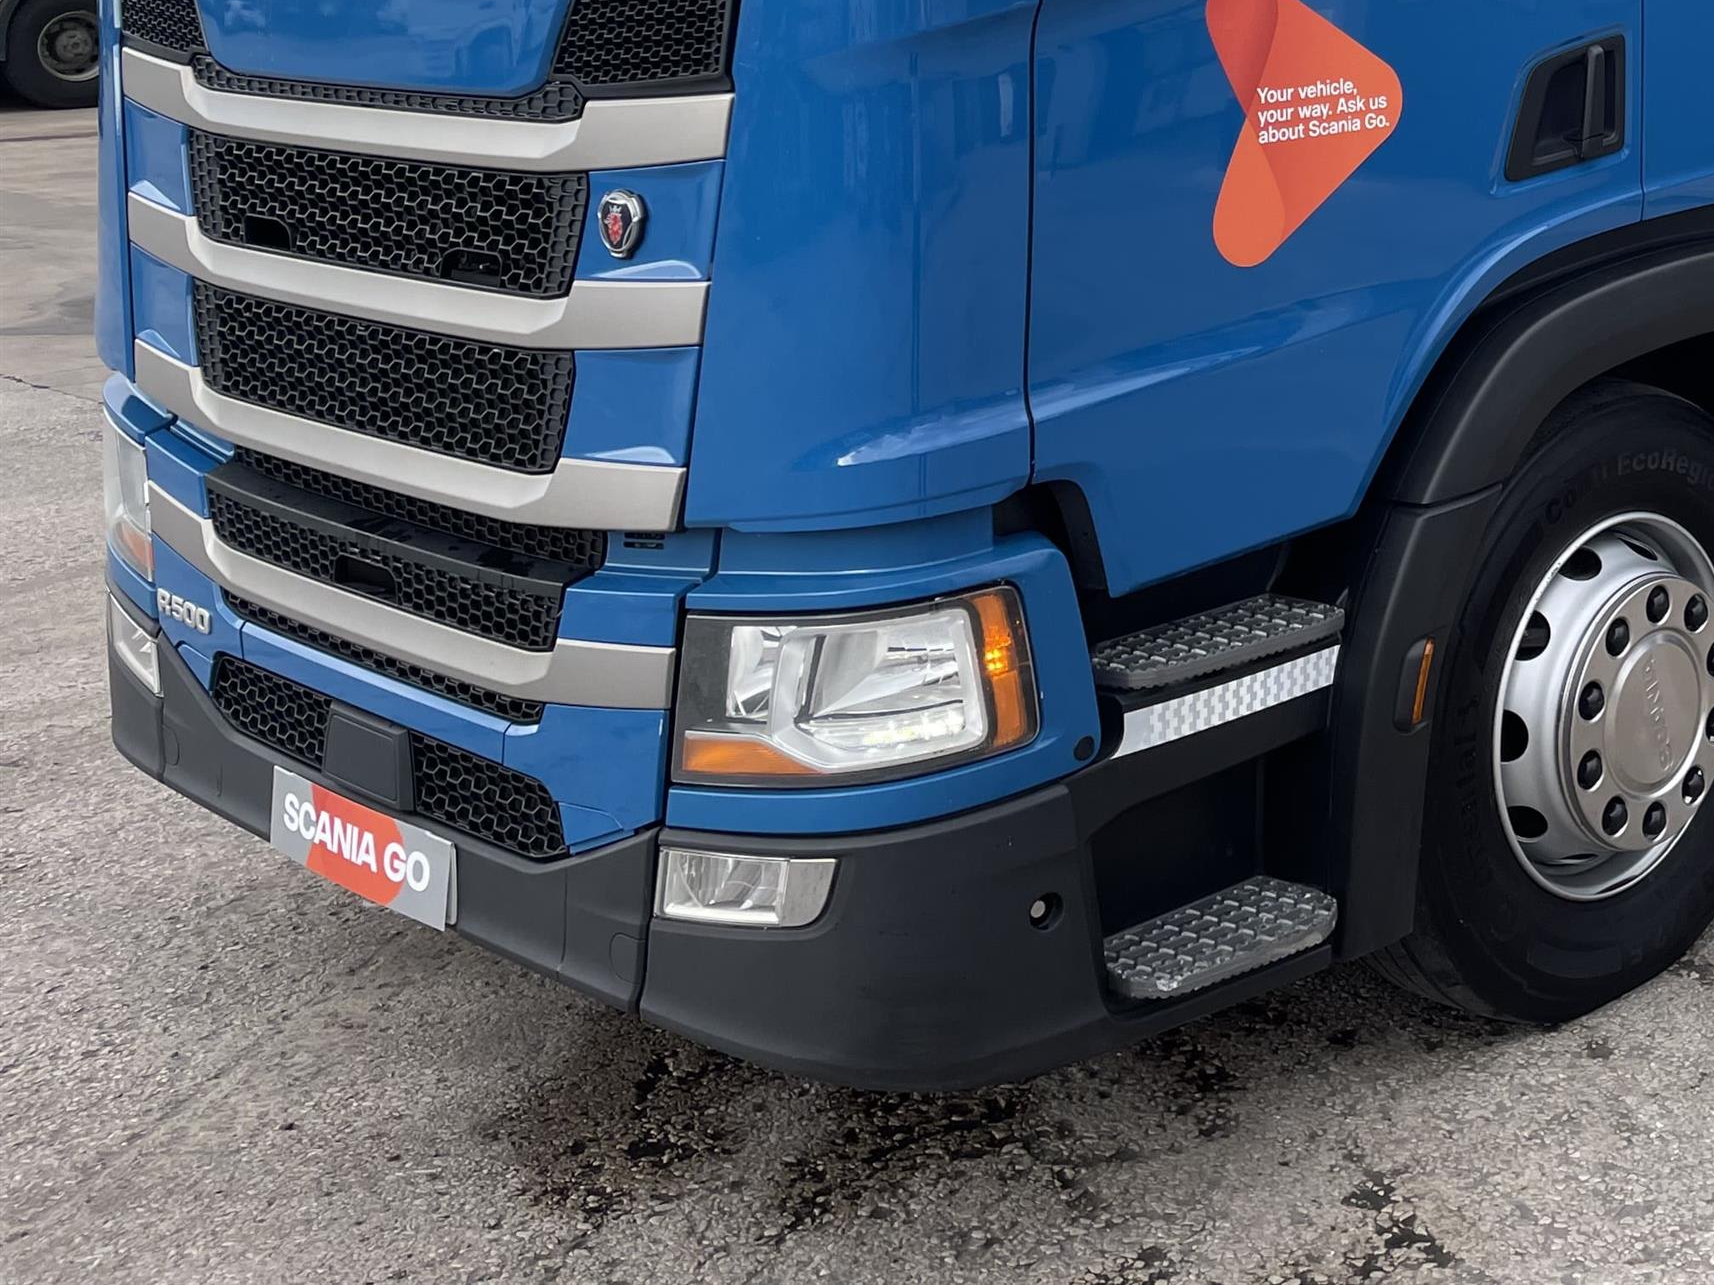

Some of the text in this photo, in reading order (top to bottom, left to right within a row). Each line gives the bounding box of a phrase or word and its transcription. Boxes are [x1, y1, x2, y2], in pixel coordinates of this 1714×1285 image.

[1257, 78, 1358, 104] Your vehicle,
[1257, 92, 1388, 127] your way. Ask us
[1257, 112, 1391, 144] about Scania Go.
[157, 587, 212, 635] R500
[282, 792, 431, 892] SCANIA GO
